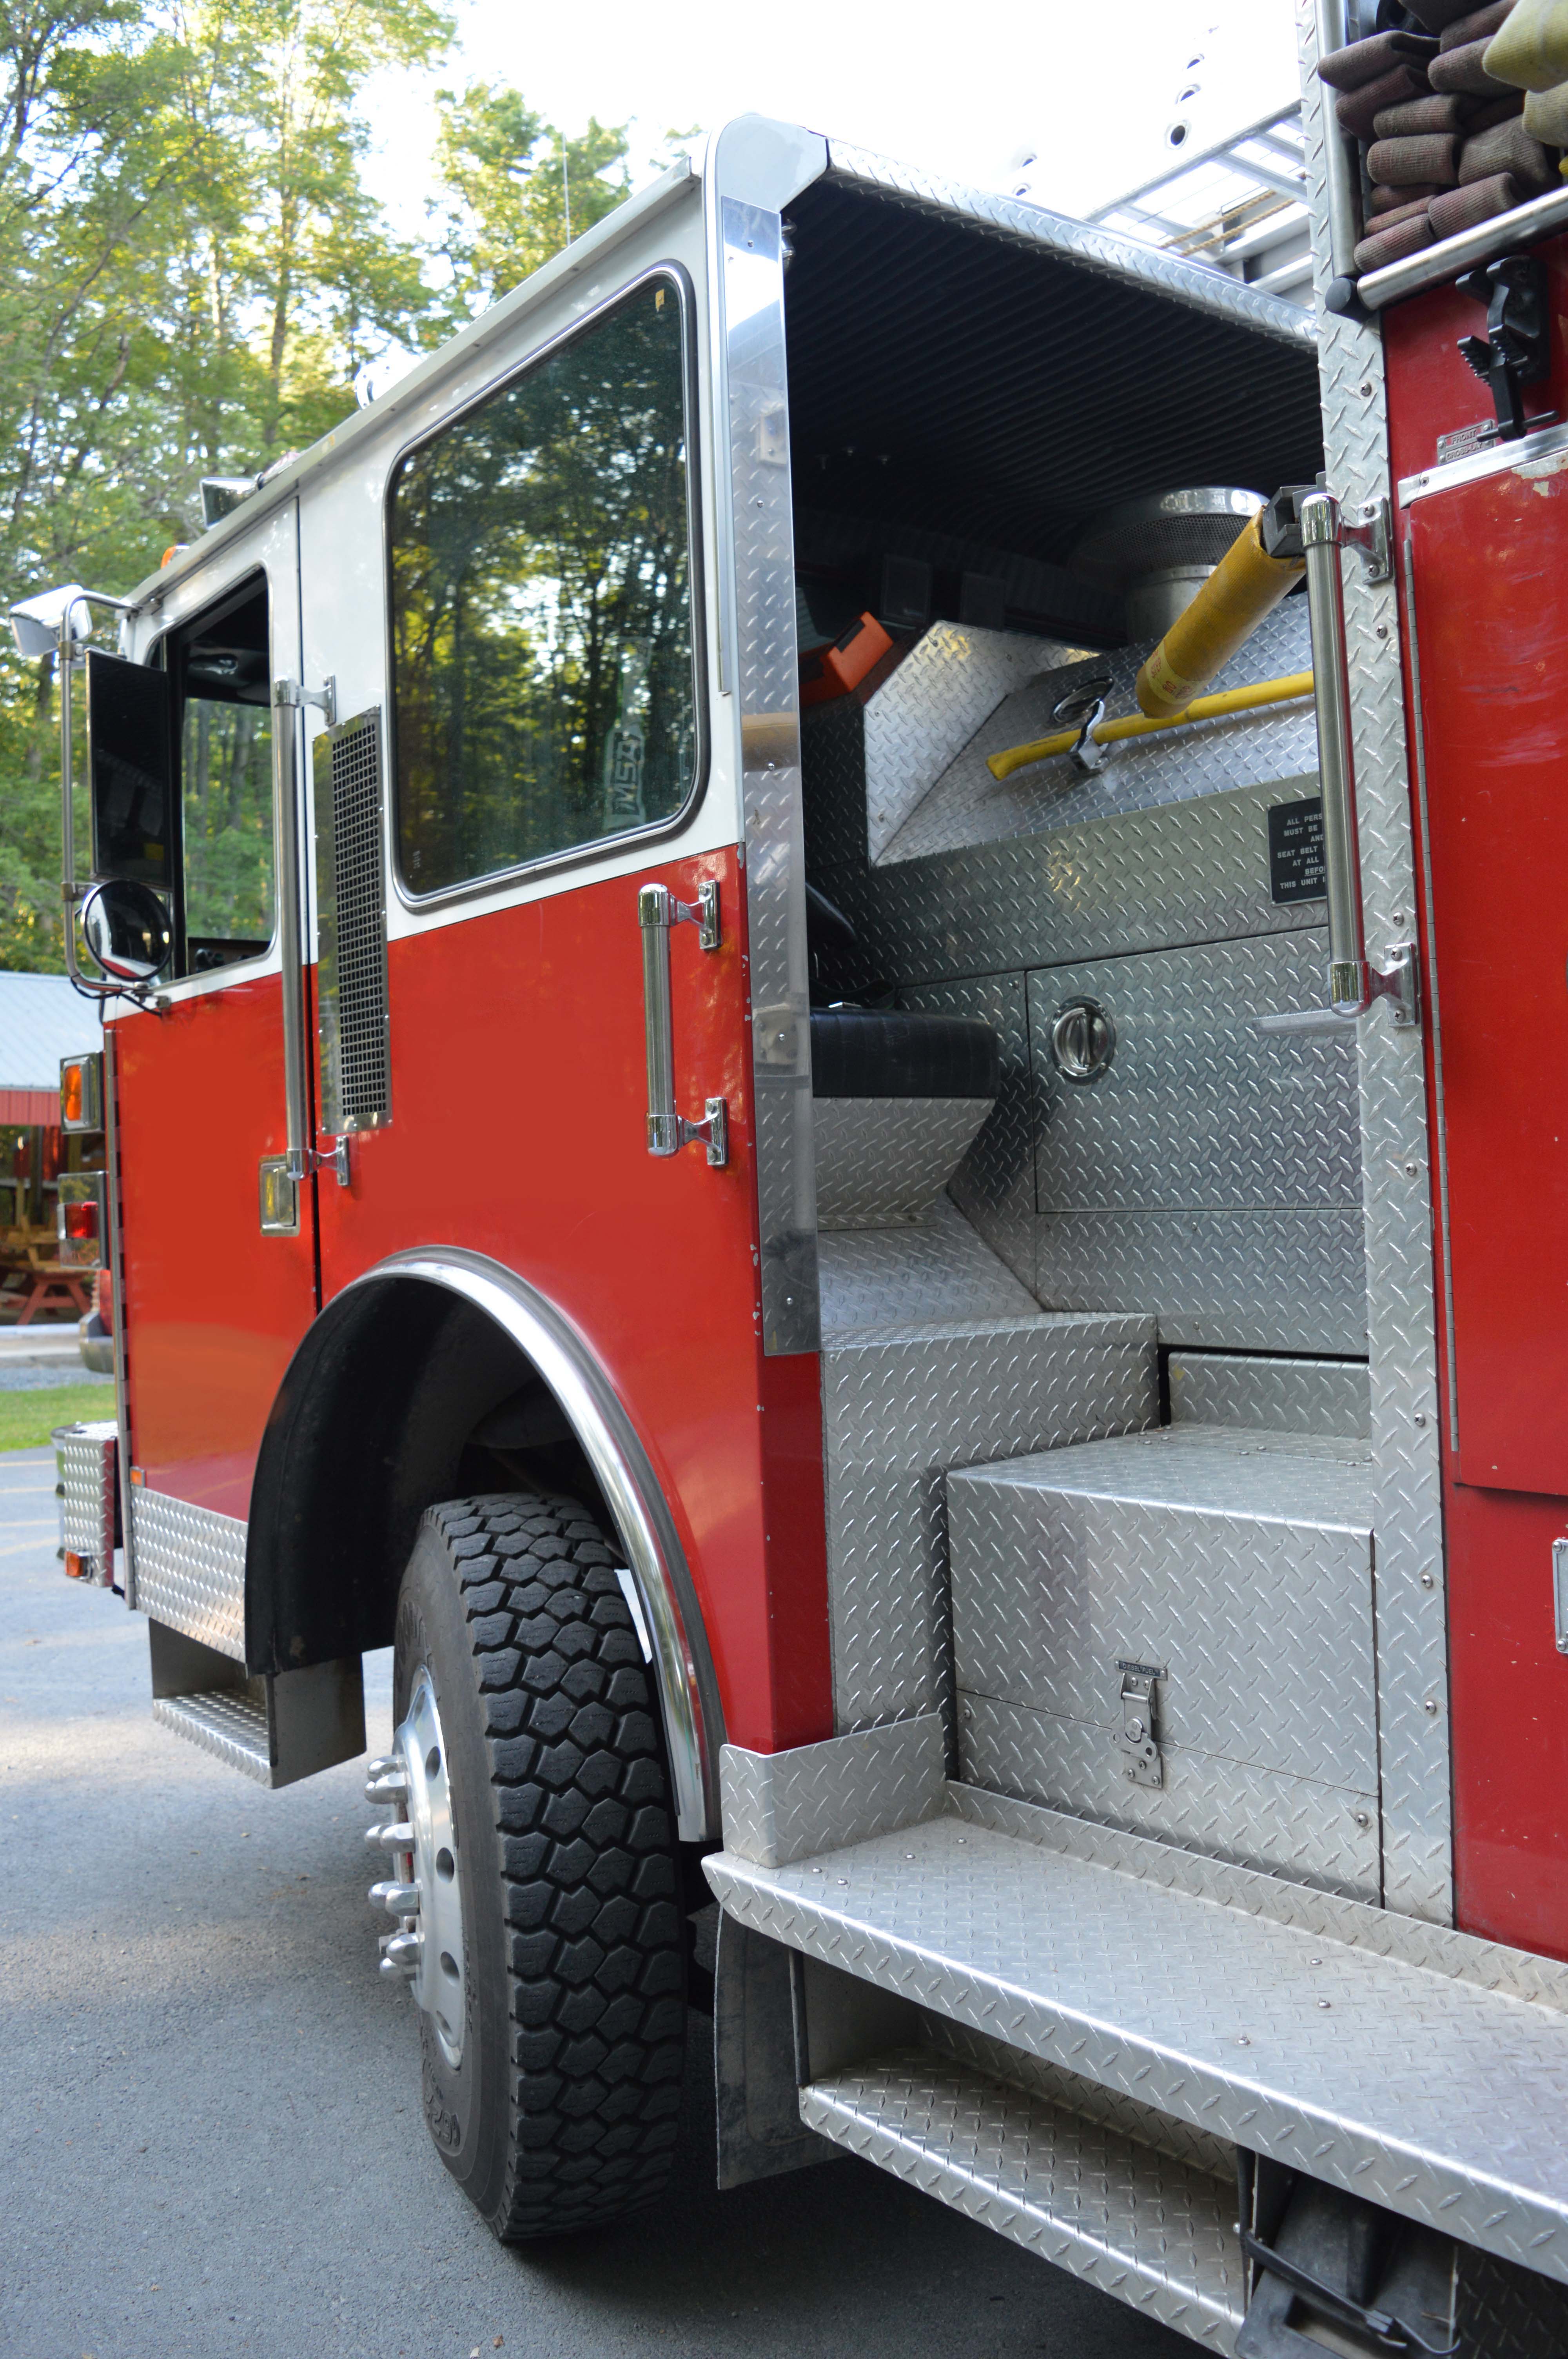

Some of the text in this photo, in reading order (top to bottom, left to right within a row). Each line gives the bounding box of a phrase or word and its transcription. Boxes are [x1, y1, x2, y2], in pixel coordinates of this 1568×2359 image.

[1452, 430, 1476, 445] FRONT
[1287, 813, 1323, 826] ALL PERS
[1284, 827, 1303, 837] MUST
[1277, 850, 1295, 859] SEAT
[1300, 846, 1318, 855] BELT
[1305, 867, 1325, 875] BEFO
[1280, 881, 1296, 889] THIS
[1123, 1663, 1140, 1672] DIESEL
